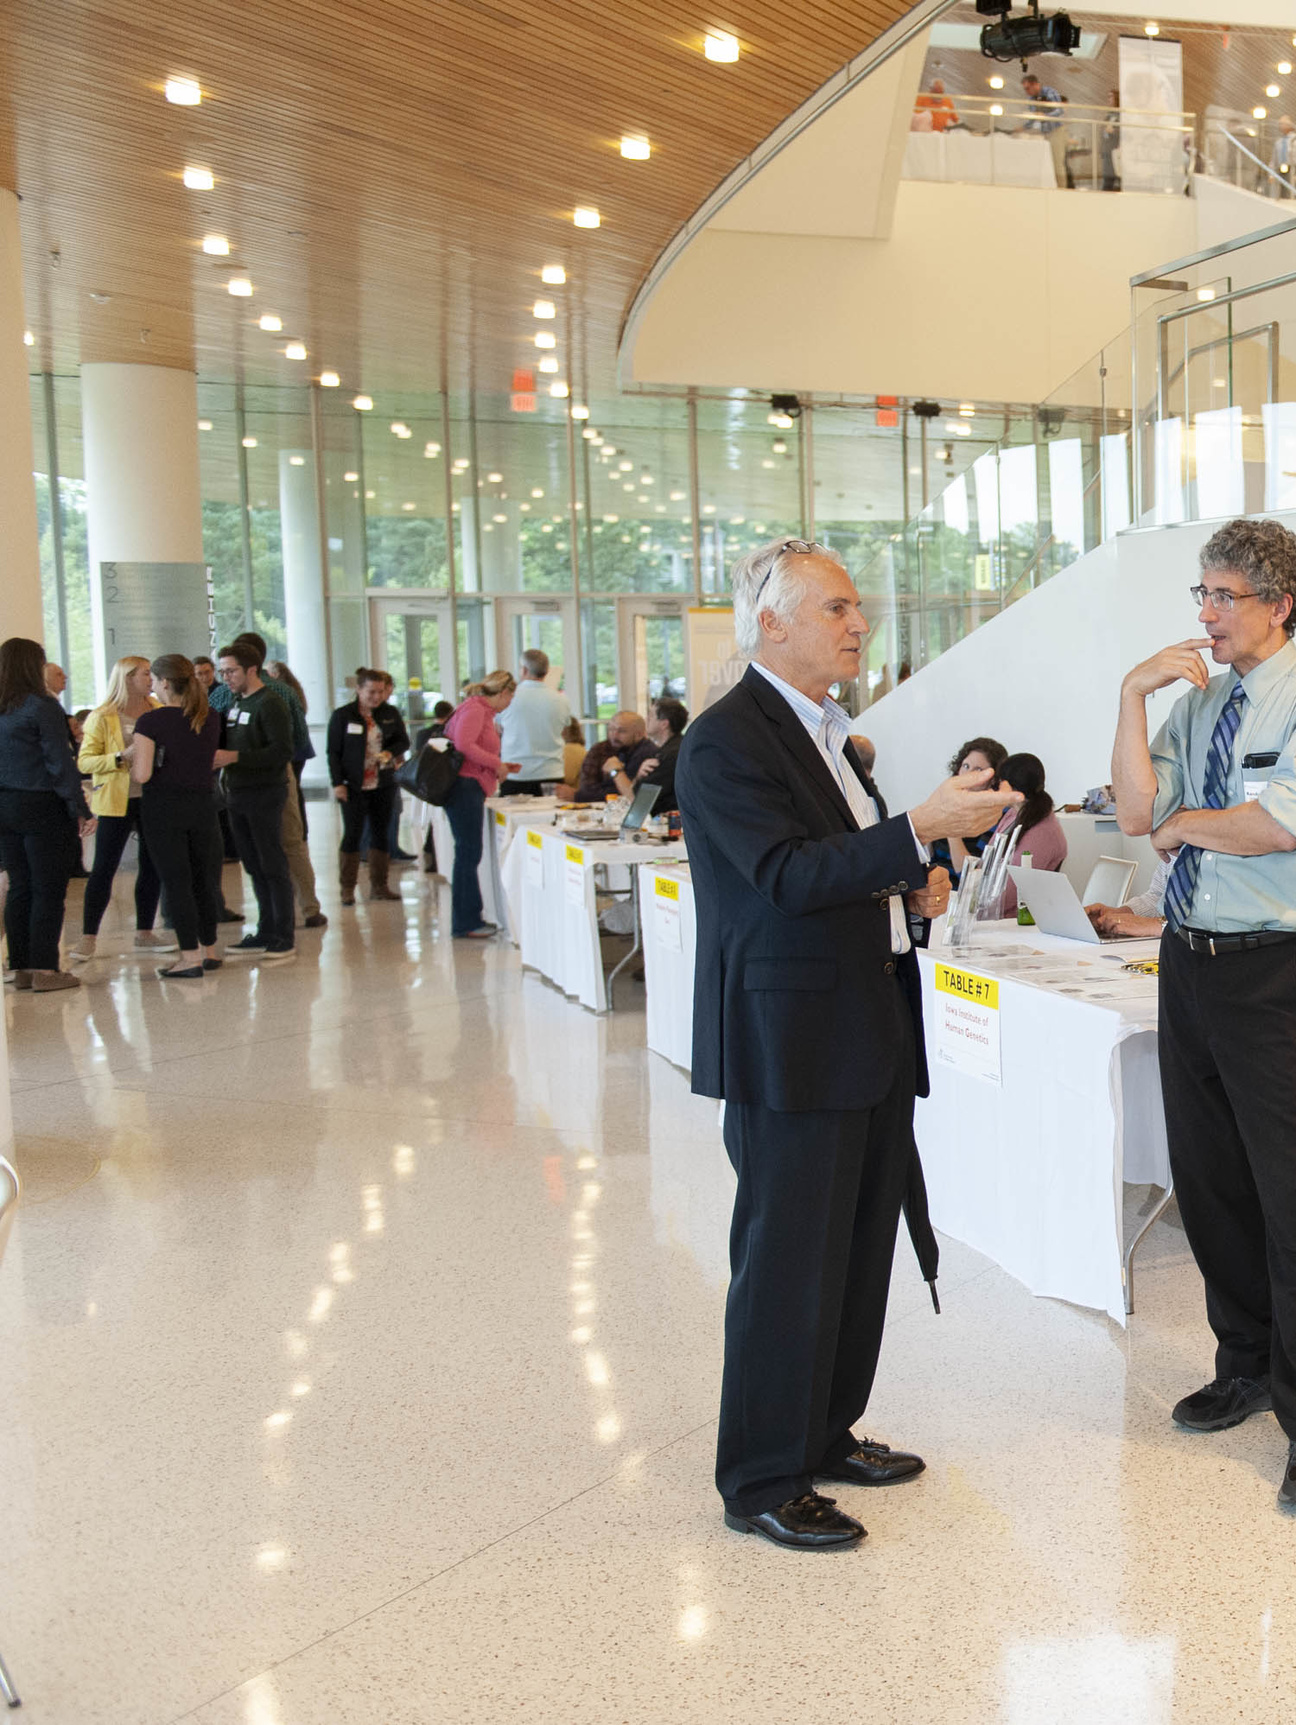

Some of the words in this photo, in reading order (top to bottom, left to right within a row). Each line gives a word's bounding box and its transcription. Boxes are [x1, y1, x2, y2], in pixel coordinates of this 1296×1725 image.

[103, 562, 117, 579] 3
[106, 586, 120, 603] 2
[107, 628, 115, 645] 1
[943, 970, 974, 995] TABLE
